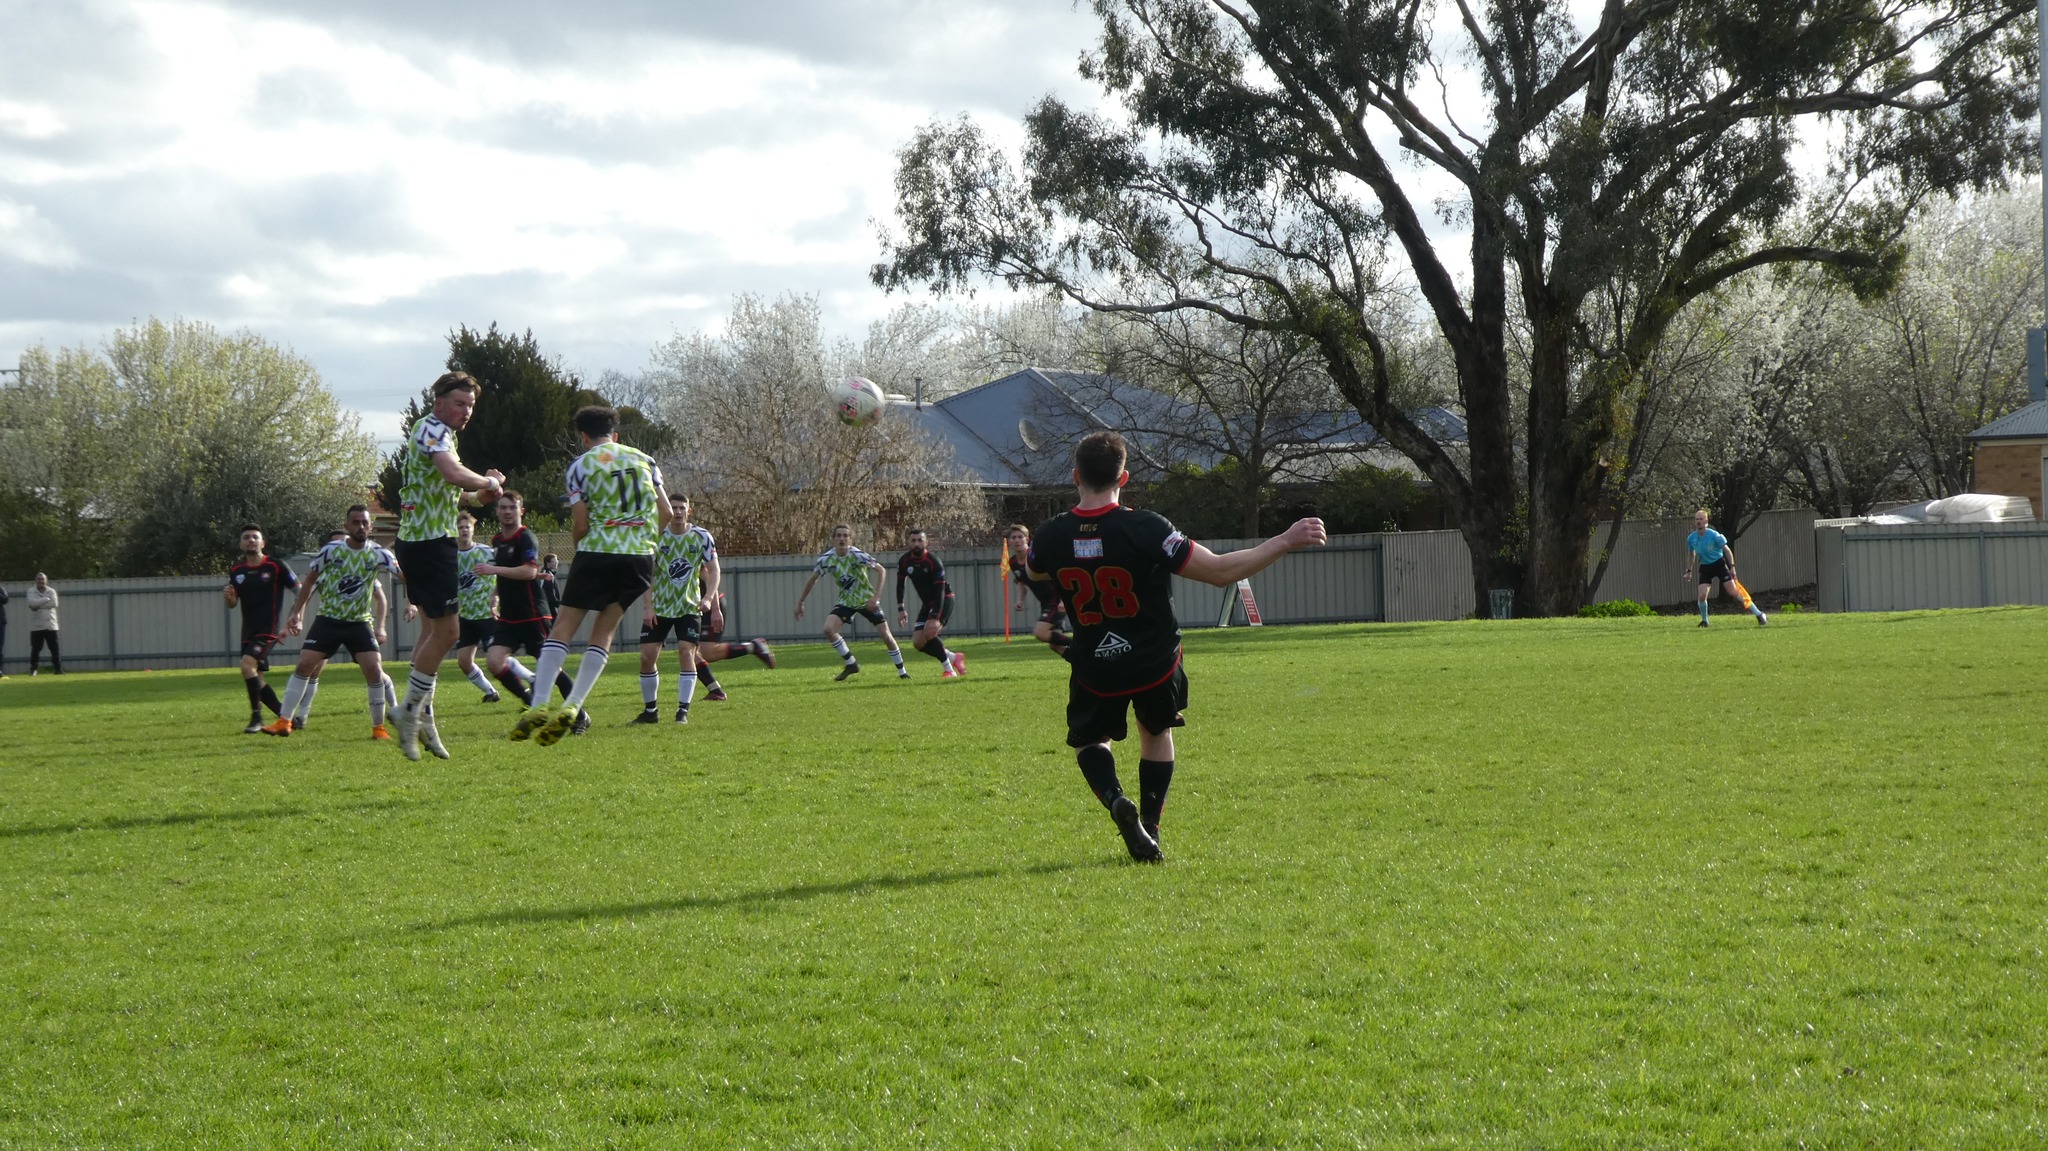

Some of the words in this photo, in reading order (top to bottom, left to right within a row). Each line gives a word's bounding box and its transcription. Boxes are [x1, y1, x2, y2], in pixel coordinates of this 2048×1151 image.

[611, 468, 641, 512] 11
[1075, 548, 1103, 556] CLUB
[1058, 566, 1139, 626] 28
[1094, 644, 1132, 658] AMATO
